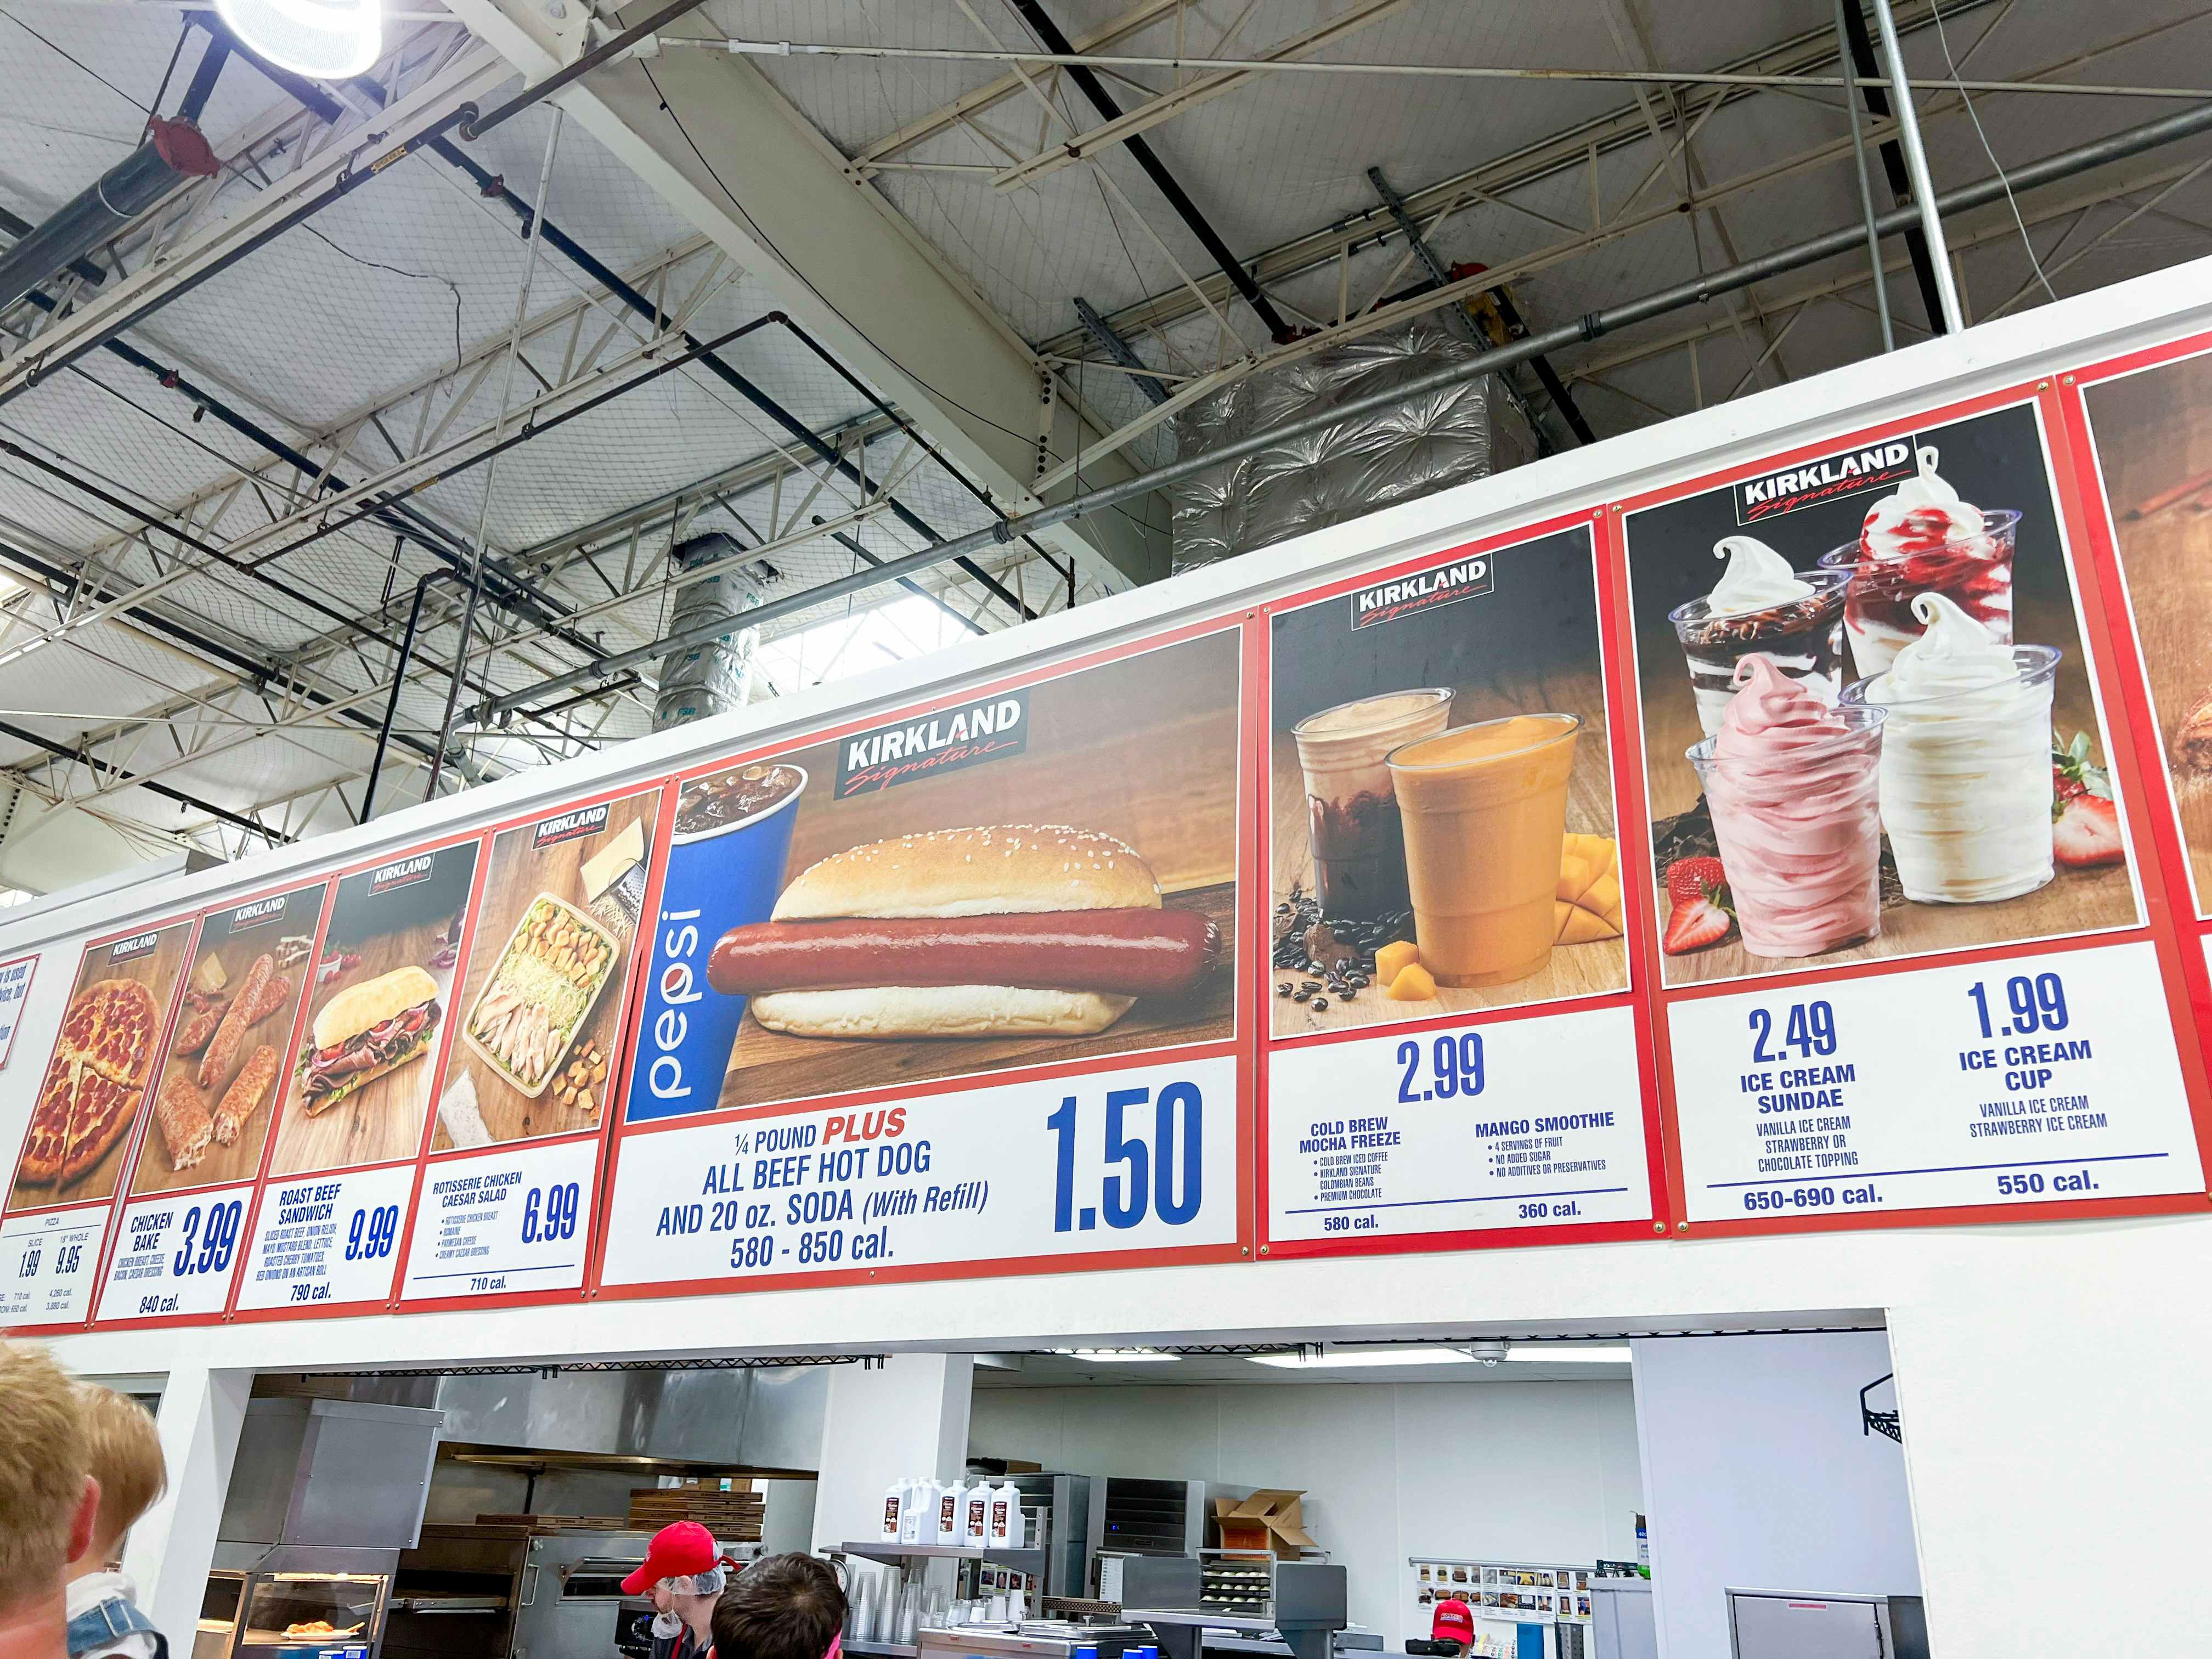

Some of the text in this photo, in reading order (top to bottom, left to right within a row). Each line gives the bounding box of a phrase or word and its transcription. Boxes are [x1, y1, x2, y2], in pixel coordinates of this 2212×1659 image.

[1745, 444, 1909, 505] KIRKLAND
[1747, 470, 1911, 521] Signature
[1359, 561, 1487, 612] KIRKLAND
[1360, 585, 1487, 627] Signature
[847, 699, 1021, 772] KIRKLAND
[844, 740, 1018, 796] Signature
[538, 807, 606, 838] KIRKLAND
[537, 826, 602, 848] Signature
[374, 855, 431, 884] KIRKLAND
[235, 897, 285, 922] KIRKLAND
[112, 934, 157, 956] KIRKLAND
[648, 909, 703, 1099] pepsi
[1967, 973, 2069, 1039] 1.99
[1748, 1001, 1837, 1063] 2.49
[1397, 1032, 1485, 1103] 2.99
[1959, 1040, 2092, 1071] ICE CREAM
[1740, 1064, 1856, 1093] ICE CREAM
[2005, 1069, 2052, 1091] CUP
[1758, 1089, 1844, 1114] SUNDAE
[1979, 1095, 2089, 1118] VANILLA ICE CREAM
[754, 1125, 816, 1153] POUND
[822, 1108, 906, 1146] PLUS
[1311, 1116, 1388, 1137] COLD BREW
[1475, 1112, 1615, 1138] MANGO SMOOTHIE
[1757, 1116, 1851, 1137] VANILLA ICE CREAM
[1970, 1113, 2108, 1138] STRAWBERRY ICE CREAM
[1300, 1132, 1401, 1154] MOCHA FREEZE
[1495, 1137, 1563, 1151] 4 SERVINGS OF FRUIT
[1765, 1135, 1846, 1154] STRAWBERRY OR
[702, 1140, 930, 1195] ALL BEEF HOT DOG
[1047, 1081, 1203, 1232] 1.50
[1320, 1152, 1388, 1167] COLD BREW ICED COFFEE
[1496, 1150, 1551, 1165] NO ADDED SUGAR
[1758, 1152, 1859, 1172] CHOCOLATE TOPPING
[1320, 1164, 1381, 1177] KIRKLAND SIGNATURE
[1496, 1160, 1606, 1178] NO ADDITIVES OR PRESERVATIVES
[279, 1183, 342, 1206] ROAST BEEF
[433, 1171, 522, 1194] ROTISSERIE CHICKEN
[1320, 1177, 1374, 1189] COLOMBIAN BEANS
[1321, 1188, 1382, 1201] PREMIUM CHOCOLATE
[1997, 1170, 2099, 1195] 550 cal.
[442, 1188, 507, 1207] CAESAR SALAD
[656, 1180, 989, 1236] AND 20 oz. SODA (With Refill)
[1743, 1184, 1883, 1211] 650-690 cal.
[279, 1203, 333, 1225] SANDWICH
[522, 1182, 579, 1244] 6.99
[1519, 1201, 1581, 1219] 360 cal.
[131, 1212, 174, 1233] CHICKEN
[345, 1205, 399, 1261] 9.99
[1324, 1214, 1379, 1231] 580 cal.
[28, 1238, 43, 1247] SLICE
[69, 1233, 89, 1242] WHOLE
[132, 1233, 160, 1251] BAKE
[173, 1200, 242, 1277] 3.99
[264, 1229, 279, 1241] SLICED
[730, 1235, 774, 1268] 580
[798, 1229, 843, 1263] 850
[851, 1226, 894, 1260] cal.
[19, 1250, 41, 1278] 1.99
[55, 1245, 82, 1274] 9.95
[290, 1282, 331, 1301] 790 cal.
[471, 1276, 506, 1290] 710 cal.
[139, 1293, 178, 1313] 840 cal.
